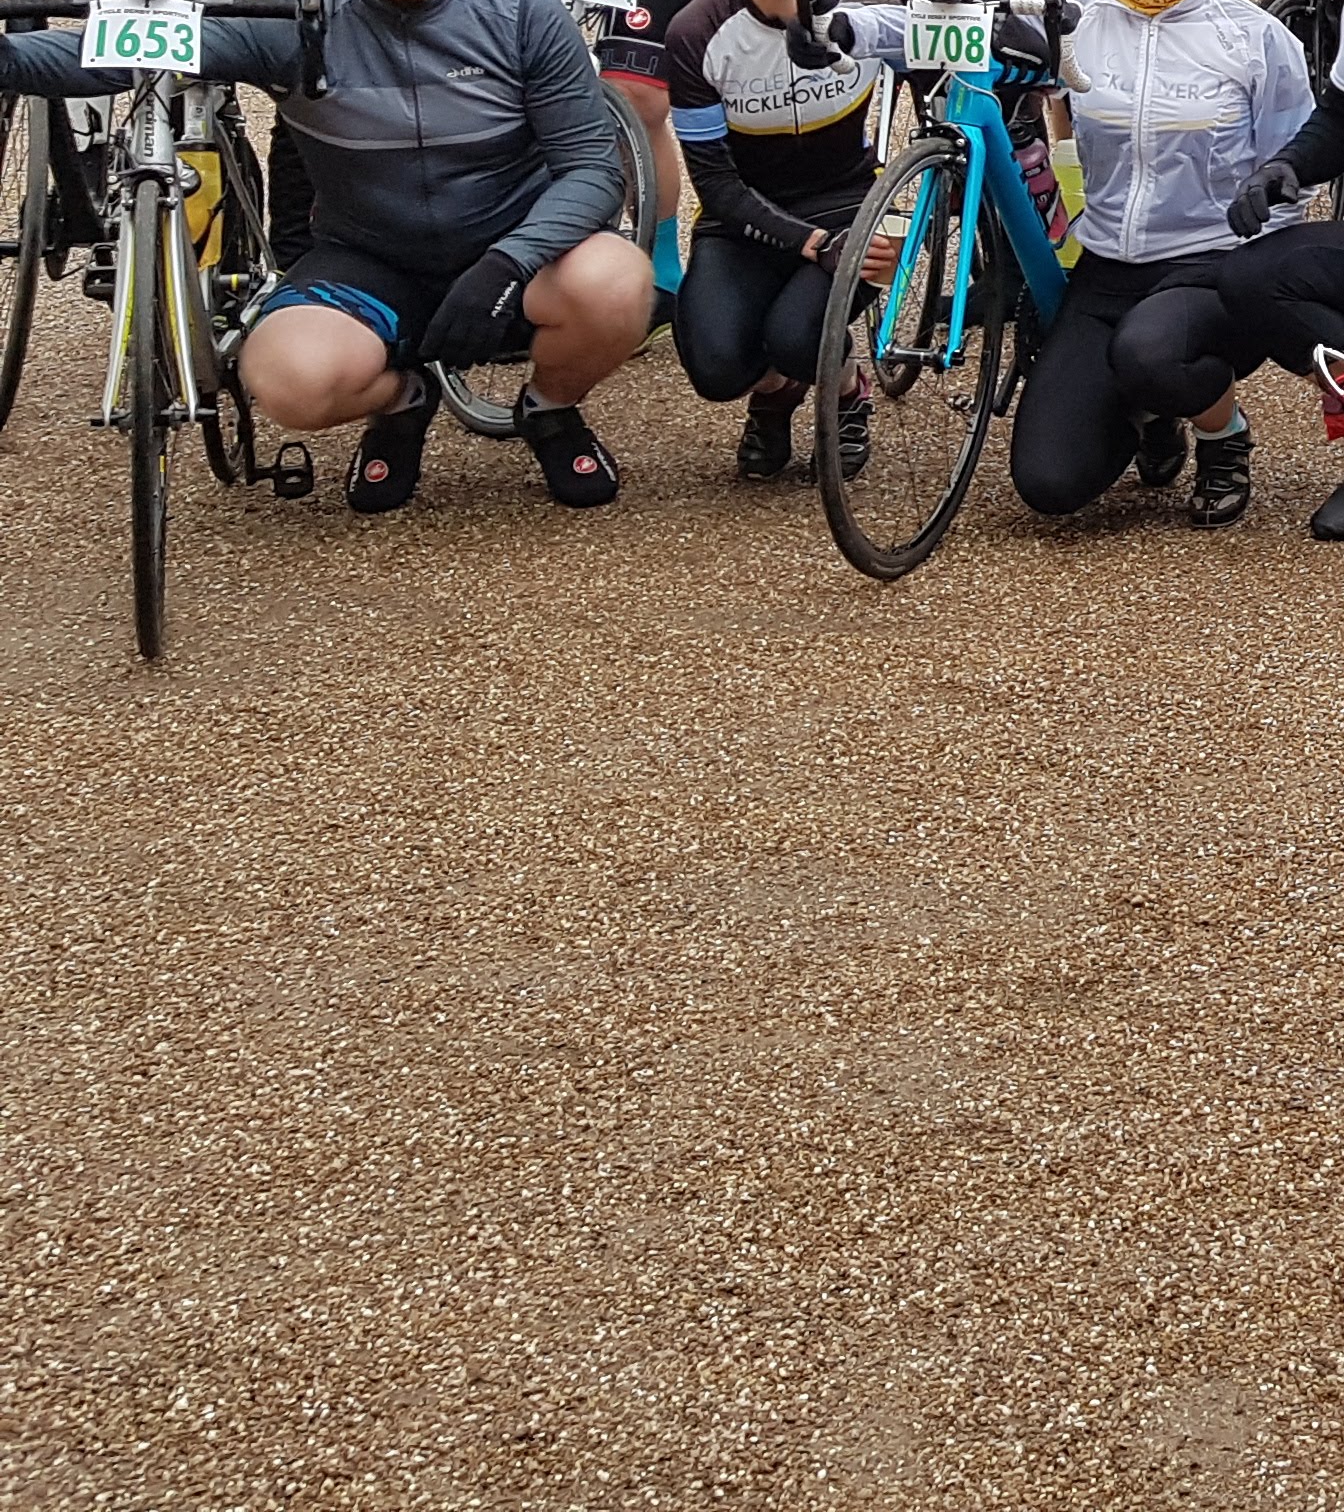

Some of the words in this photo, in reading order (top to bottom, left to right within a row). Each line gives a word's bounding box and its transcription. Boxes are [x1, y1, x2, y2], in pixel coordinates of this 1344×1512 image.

[95, 18, 195, 63] 1653
[911, 23, 986, 64] 1708
[724, 79, 846, 115] MICKLEOVER
